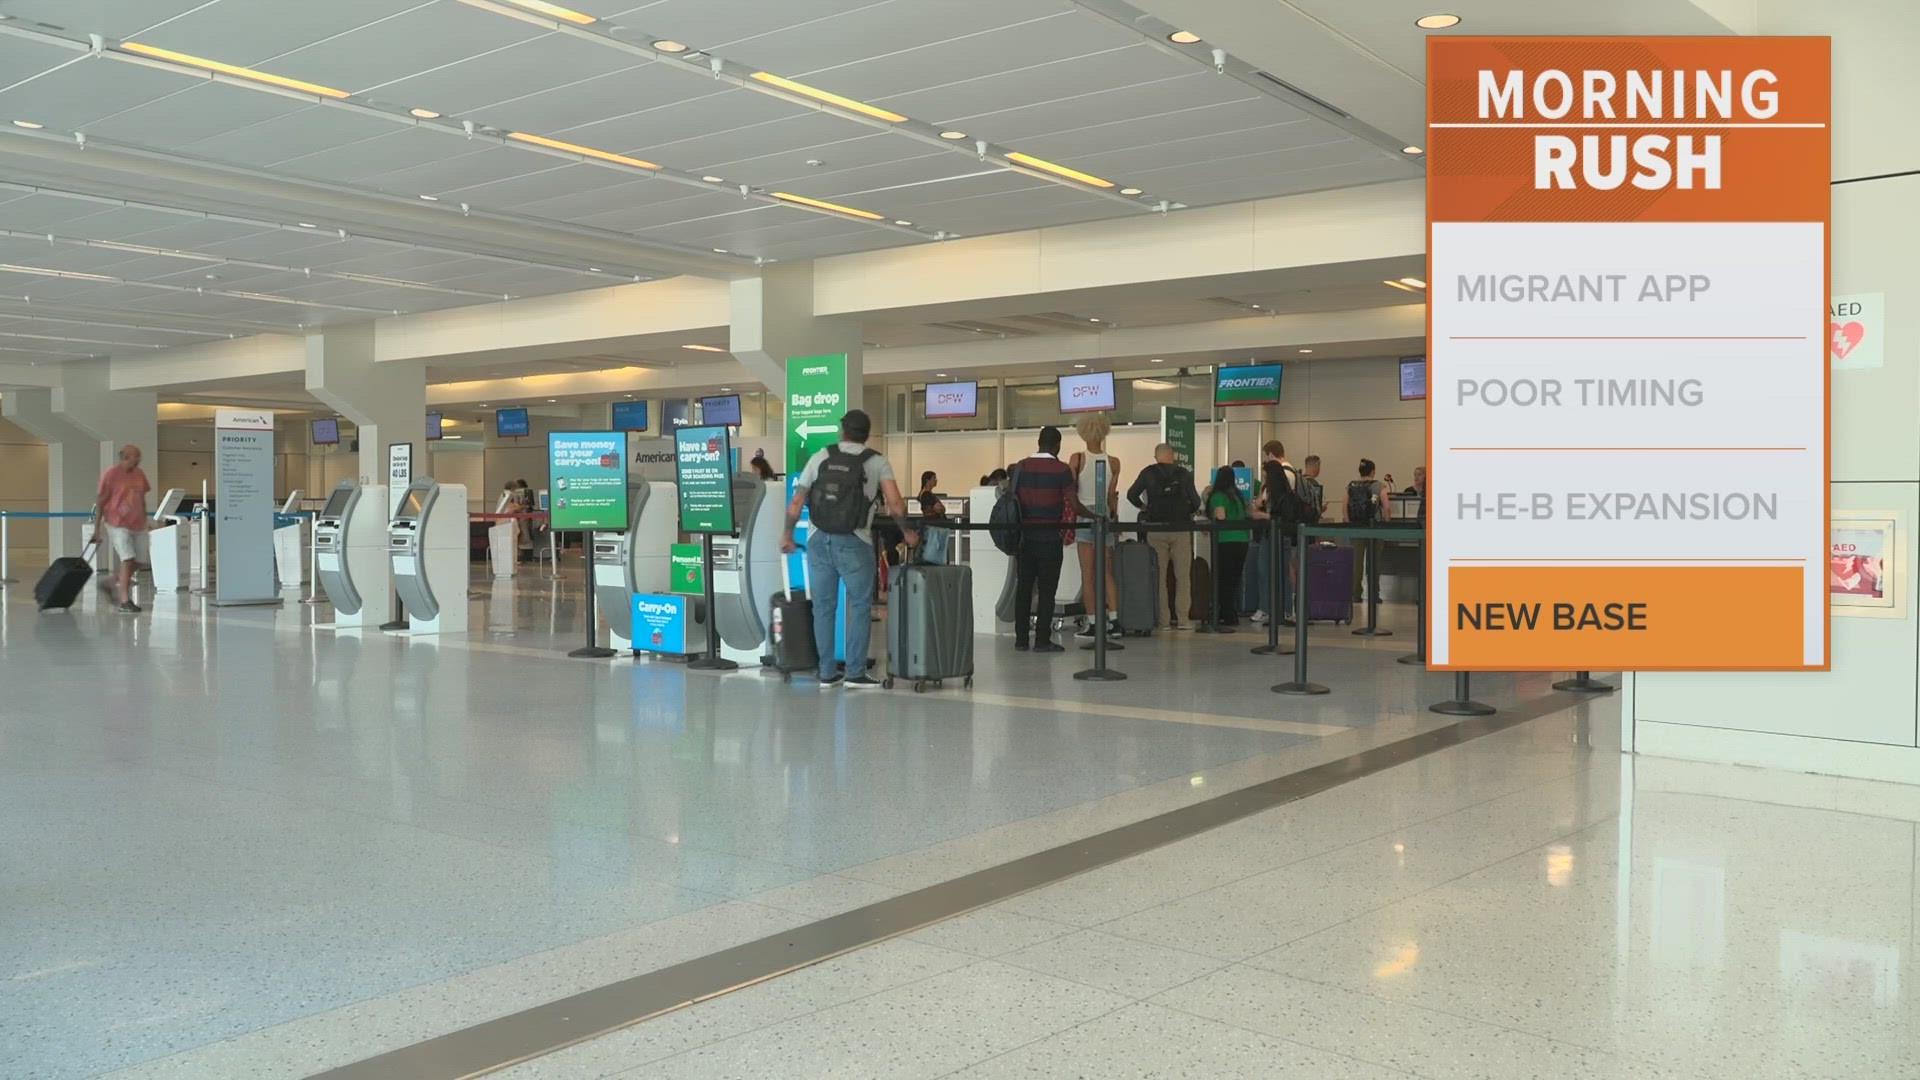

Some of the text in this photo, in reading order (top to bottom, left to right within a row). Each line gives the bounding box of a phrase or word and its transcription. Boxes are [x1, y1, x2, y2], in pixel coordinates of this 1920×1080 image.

[1218, 377, 1274, 389] FRONTIER
[1072, 386, 1100, 397] DFW
[791, 391, 840, 407] Bag drop
[938, 393, 963, 404] DFW
[1168, 429, 1184, 438] Start
[554, 440, 616, 451] Save money
[679, 441, 708, 452] Have a
[554, 450, 593, 459] on your
[635, 451, 676, 463] American
[680, 450, 720, 463] carry-on?
[1833, 543, 1857, 552] AED
[638, 601, 677, 615] Carry-On
